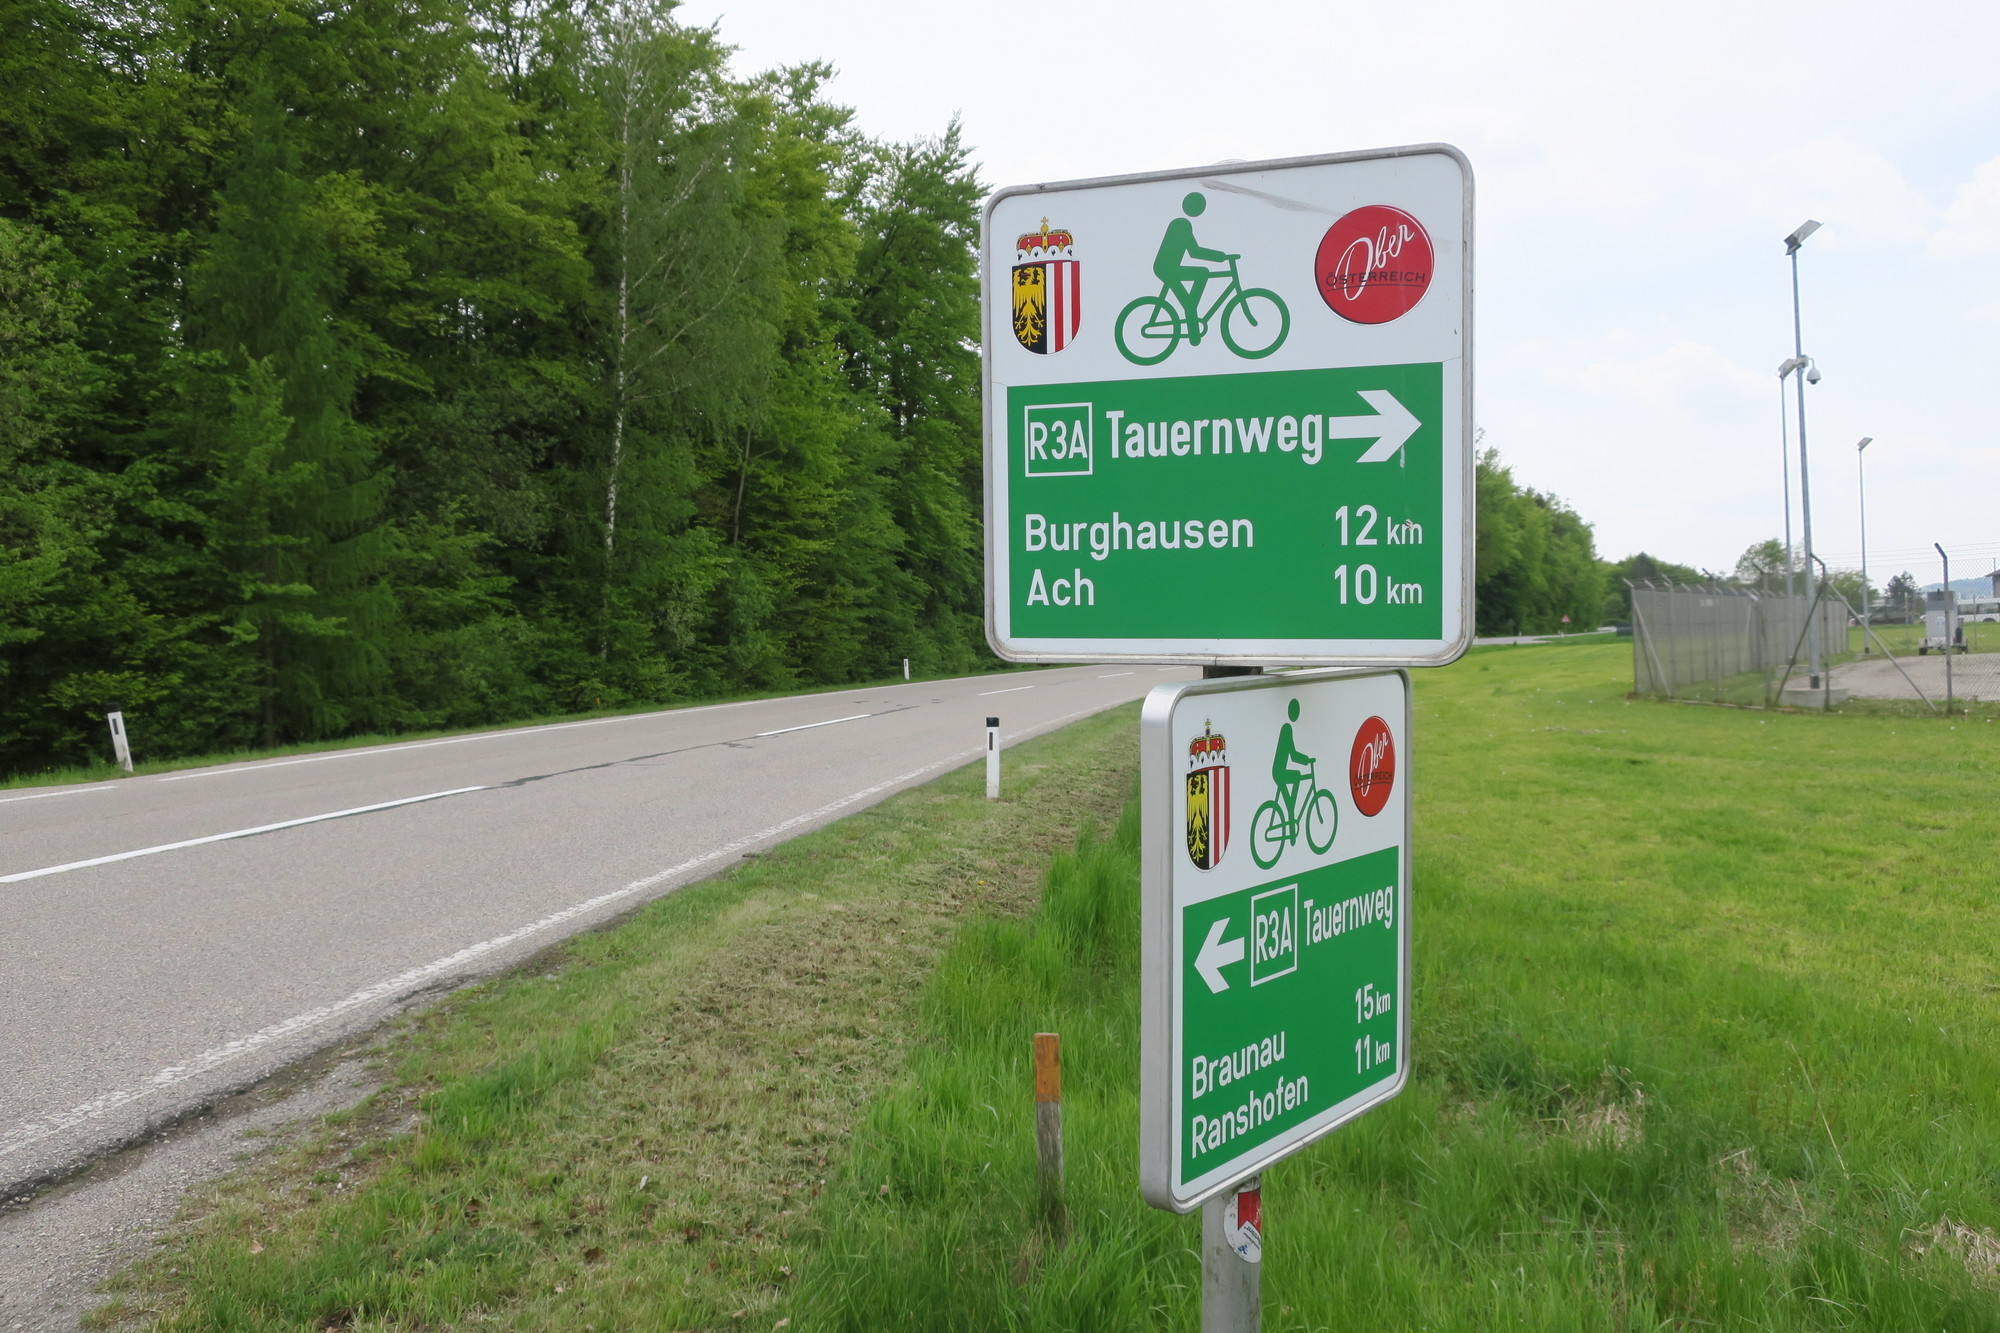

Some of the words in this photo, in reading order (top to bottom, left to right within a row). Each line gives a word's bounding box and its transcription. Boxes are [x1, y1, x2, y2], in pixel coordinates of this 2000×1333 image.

[1325, 271, 1427, 288] ÖSTERREICH
[1333, 223, 1416, 301] Ober
[1029, 419, 1089, 461] R3A
[1105, 409, 1324, 465] Tauernweg
[1025, 511, 1255, 562] Burghausen
[1335, 504, 1379, 547] 12
[1386, 516, 1424, 546] km
[1026, 567, 1096, 607] Ach
[1334, 563, 1378, 605] 10
[1386, 575, 1424, 605] km
[1255, 906, 1294, 965] R3A
[1303, 885, 1394, 946] Tauernweg
[1192, 1031, 1286, 1100] Braunau
[1355, 983, 1375, 1024] 15
[1375, 991, 1391, 1016] km
[1191, 1075, 1309, 1160] Ranshofen
[1355, 1034, 1371, 1075] 11
[1375, 1040, 1391, 1066] km
